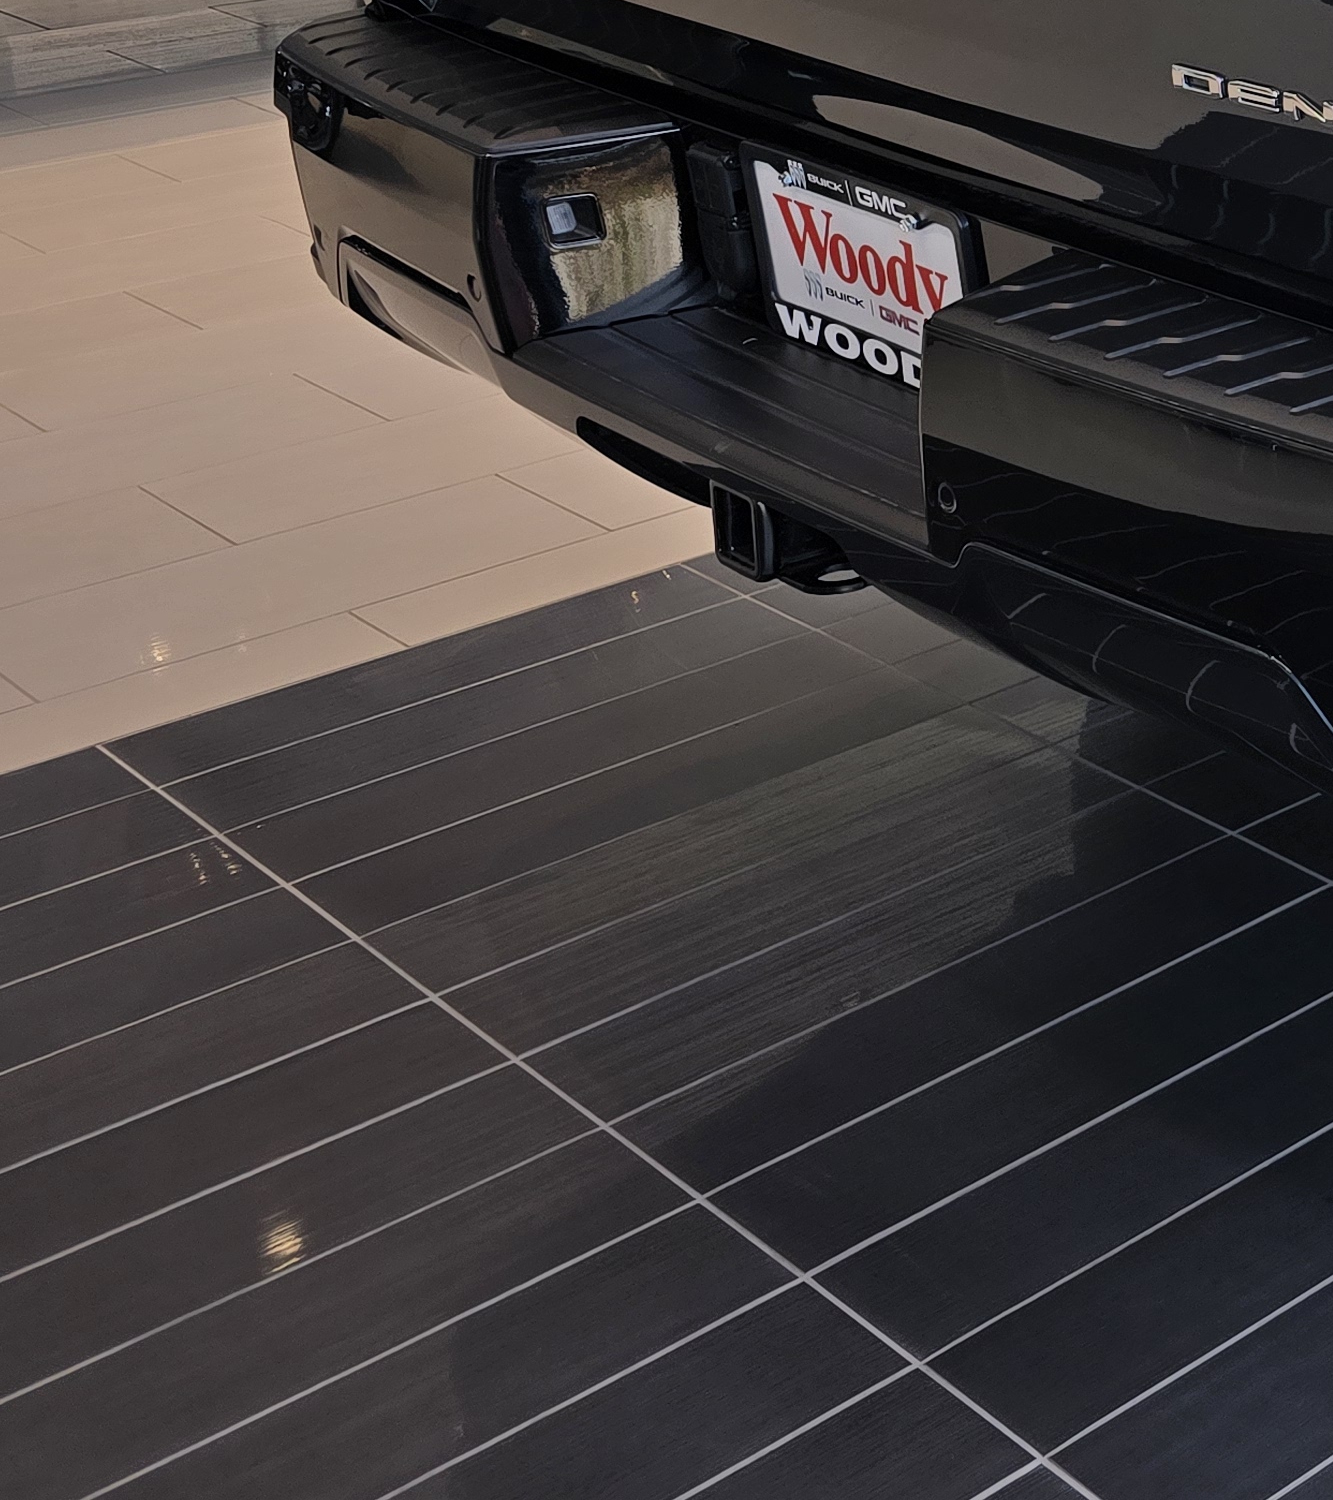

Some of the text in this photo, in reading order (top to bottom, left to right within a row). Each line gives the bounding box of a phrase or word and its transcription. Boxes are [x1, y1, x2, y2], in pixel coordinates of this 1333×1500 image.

[806, 174, 909, 220] BUICK GMC
[772, 193, 949, 322] Woody
[825, 286, 921, 336] BUICK GMC
